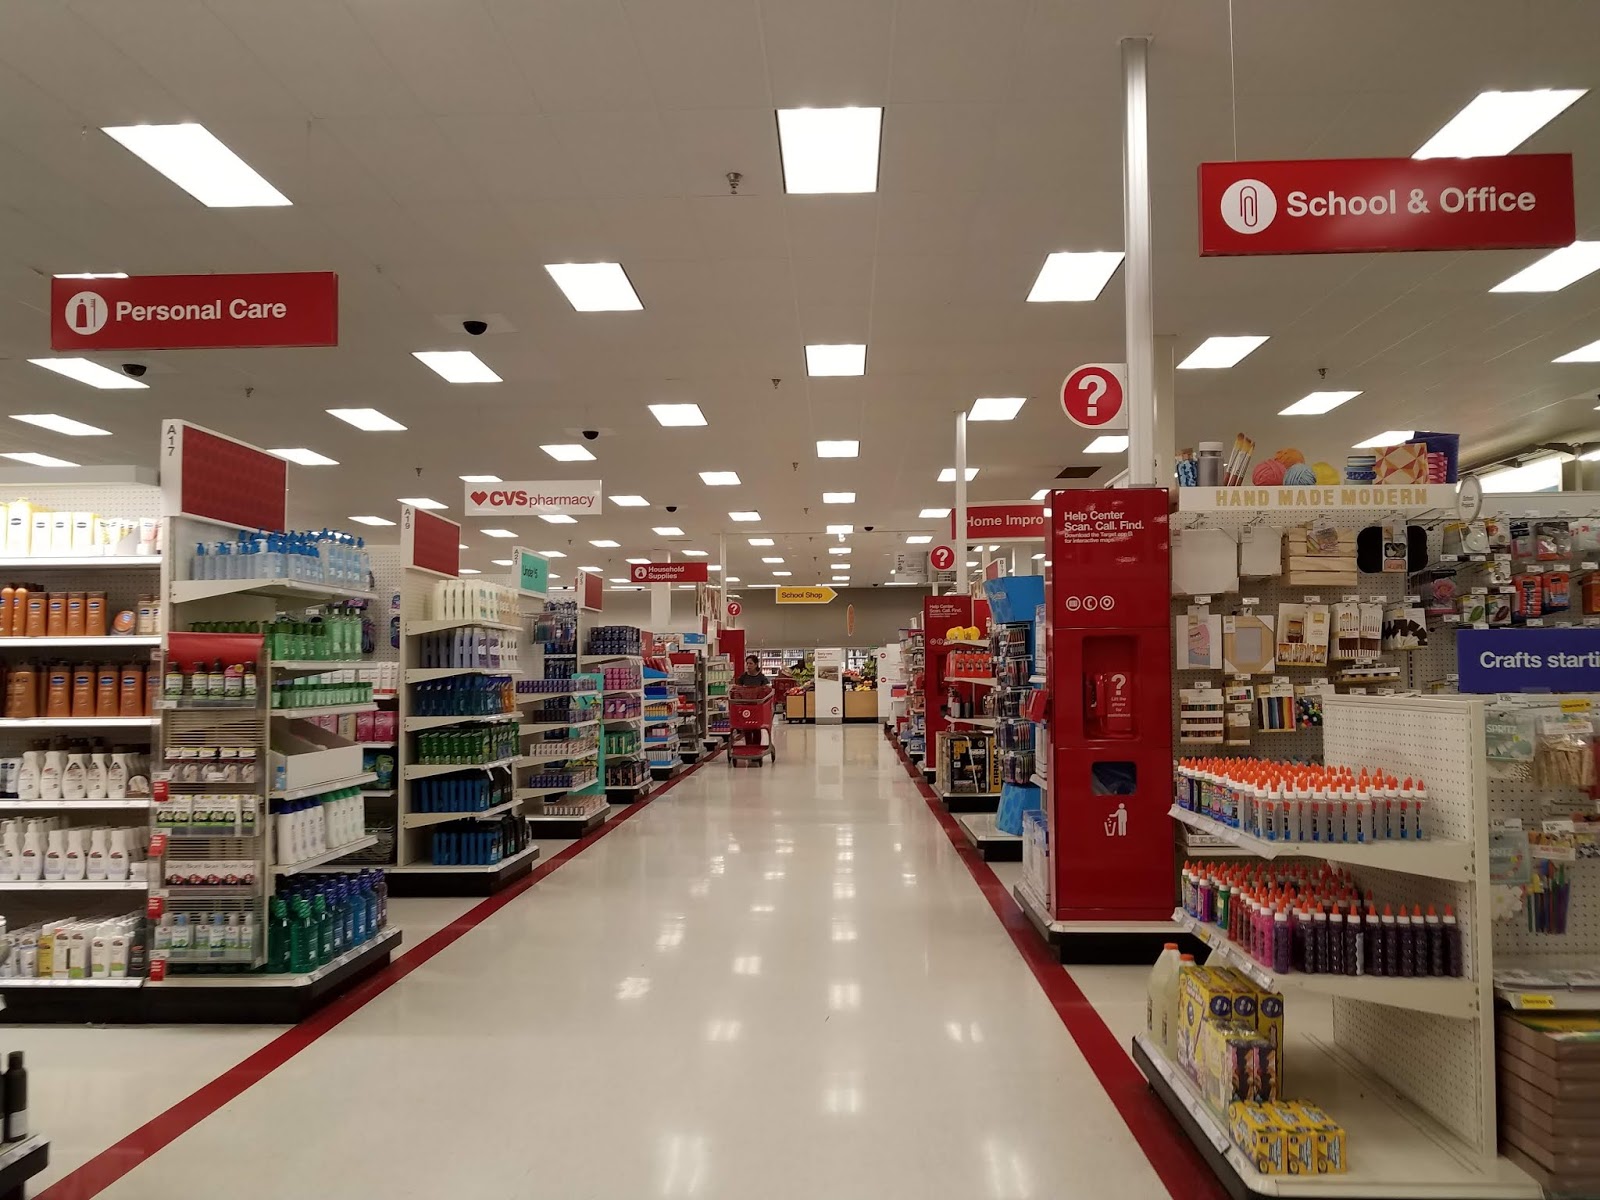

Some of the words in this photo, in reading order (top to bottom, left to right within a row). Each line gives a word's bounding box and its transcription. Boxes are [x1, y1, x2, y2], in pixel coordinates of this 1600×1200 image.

[1286, 190, 1396, 217] School
[1407, 188, 1430, 214] &
[1440, 186, 1536, 213] Office
[116, 300, 221, 321] Personal
[229, 298, 287, 320] Care
[167, 424, 177, 457] A17
[490, 490, 527, 506] CVS
[529, 494, 595, 509] pharmacy
[1215, 489, 1270, 507] HAND
[1278, 489, 1334, 506] MADE
[1341, 488, 1428, 506] MODERN
[967, 516, 1002, 527] Home
[1064, 511, 1087, 522] Help
[1090, 510, 1124, 520] Center
[1064, 521, 1093, 532] Scan.
[1095, 521, 1117, 531] Call.
[1120, 520, 1144, 530] Find.
[805, 591, 823, 600] Shop
[1480, 651, 1542, 668] Crafts
[1547, 650, 1600, 668] starti
[1486, 724, 1517, 735] SPRITZ
